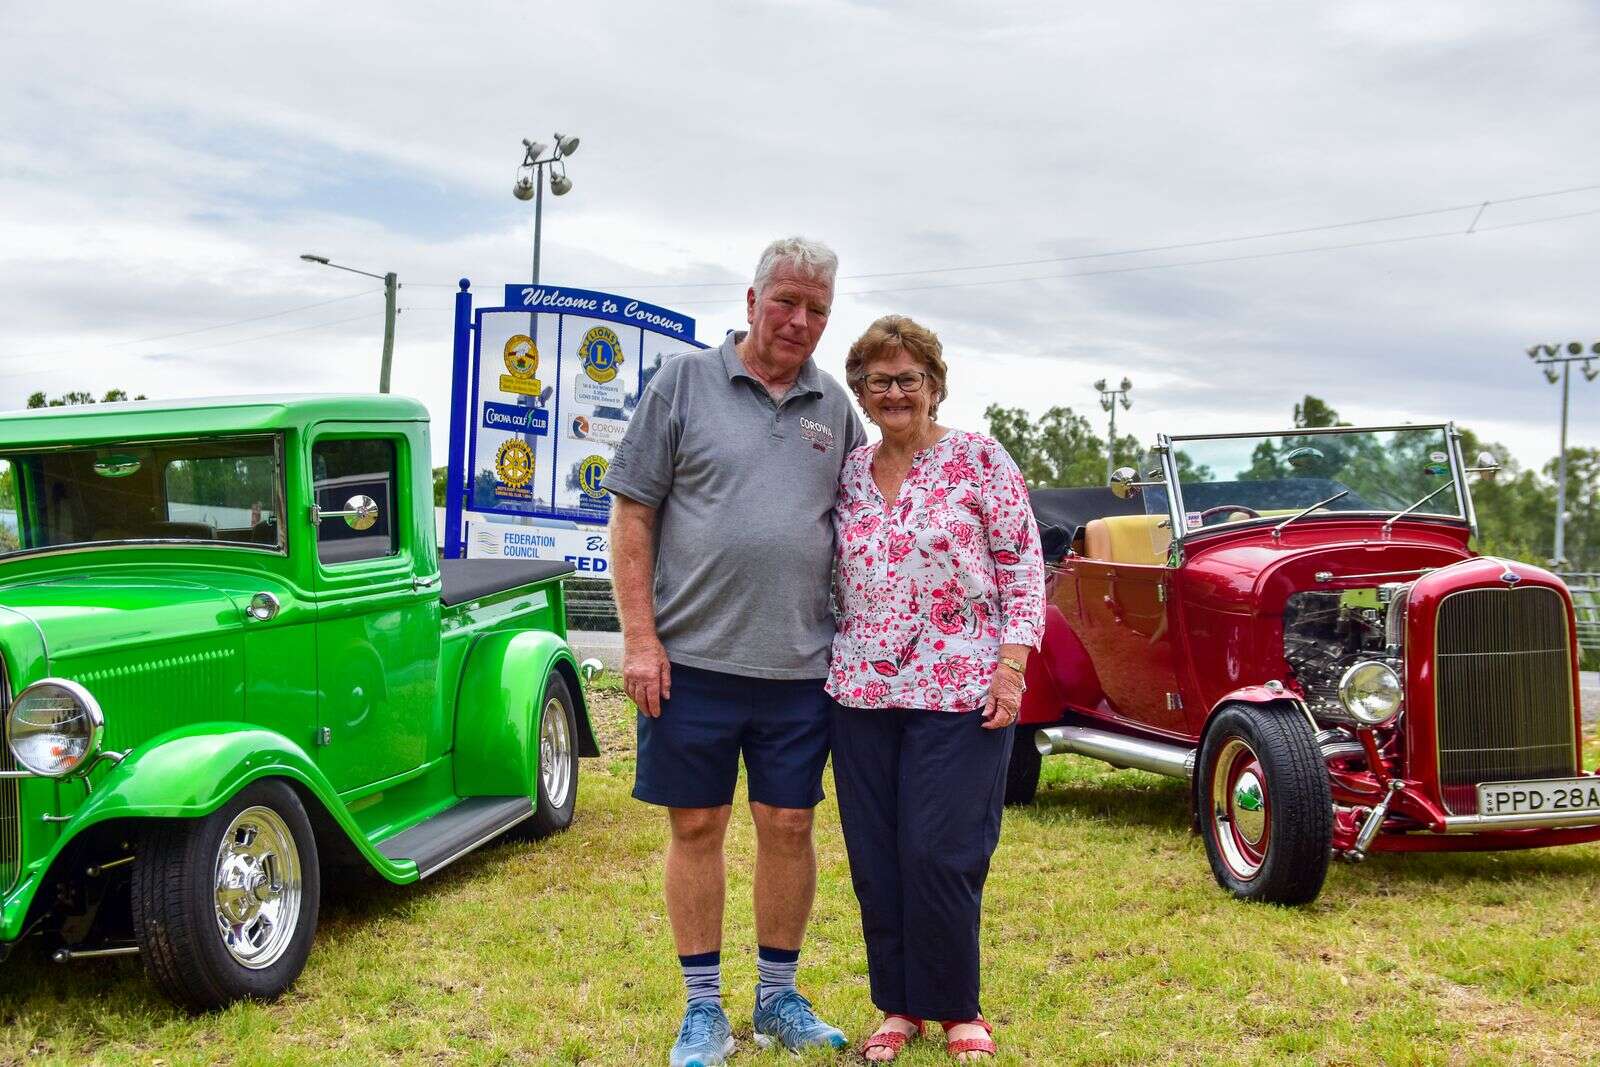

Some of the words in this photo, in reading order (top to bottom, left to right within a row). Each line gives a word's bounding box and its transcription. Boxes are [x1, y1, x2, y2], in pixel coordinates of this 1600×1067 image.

[521, 287, 598, 311] Welcome
[602, 300, 619, 313] to
[624, 301, 685, 334] Corowa
[589, 329, 617, 342] LIONS
[595, 344, 607, 365] L
[485, 408, 512, 424] COROWA
[512, 416, 527, 426] GOLF
[532, 419, 547, 429] CLUB
[591, 422, 625, 433] COROWA
[800, 417, 834, 438] COROWA
[503, 532, 556, 548] FEDERATION
[586, 535, 609, 552] Bi
[503, 545, 540, 558] COUNCIL
